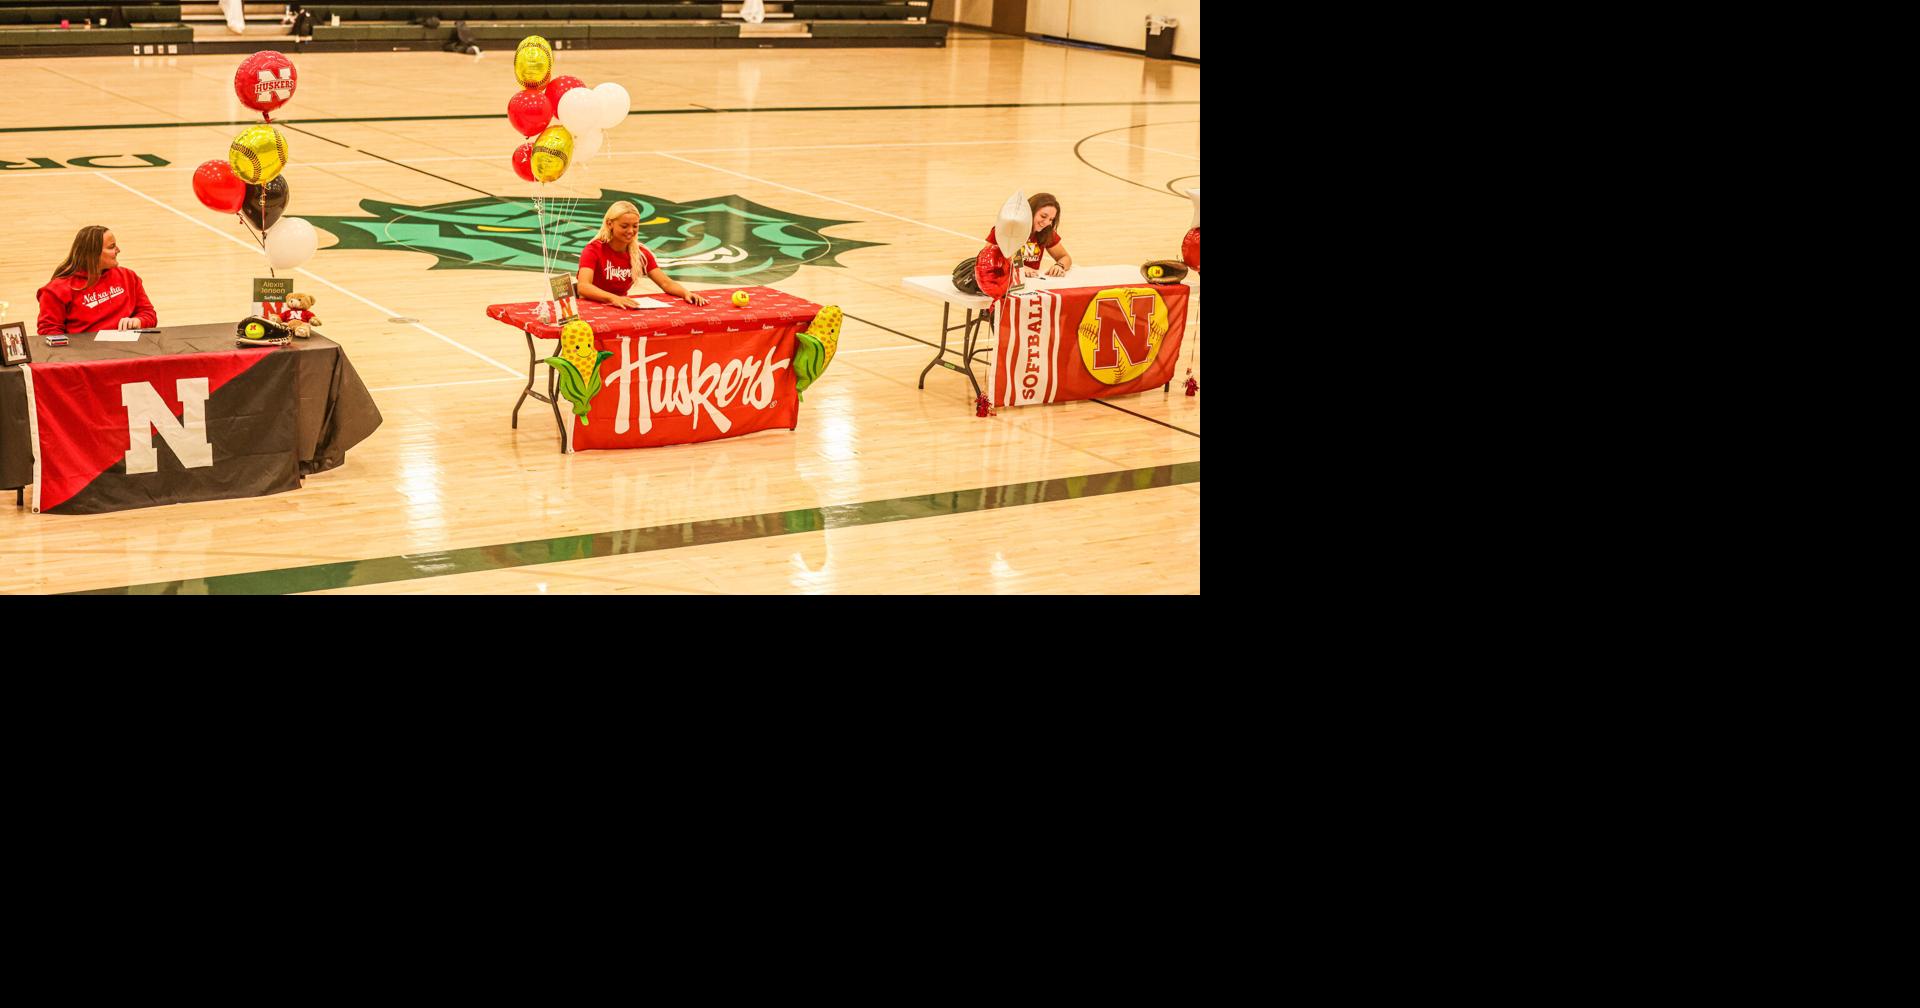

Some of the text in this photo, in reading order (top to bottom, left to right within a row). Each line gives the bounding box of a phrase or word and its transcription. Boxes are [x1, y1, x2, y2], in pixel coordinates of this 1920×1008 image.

[255, 80, 294, 93] HUSKERS
[604, 259, 631, 281] Husker
[290, 310, 302, 320] N
[1022, 294, 1043, 400] SOFTBALL
[1092, 294, 1156, 371] N
[604, 336, 791, 434] Huskers
[121, 376, 213, 475] N
